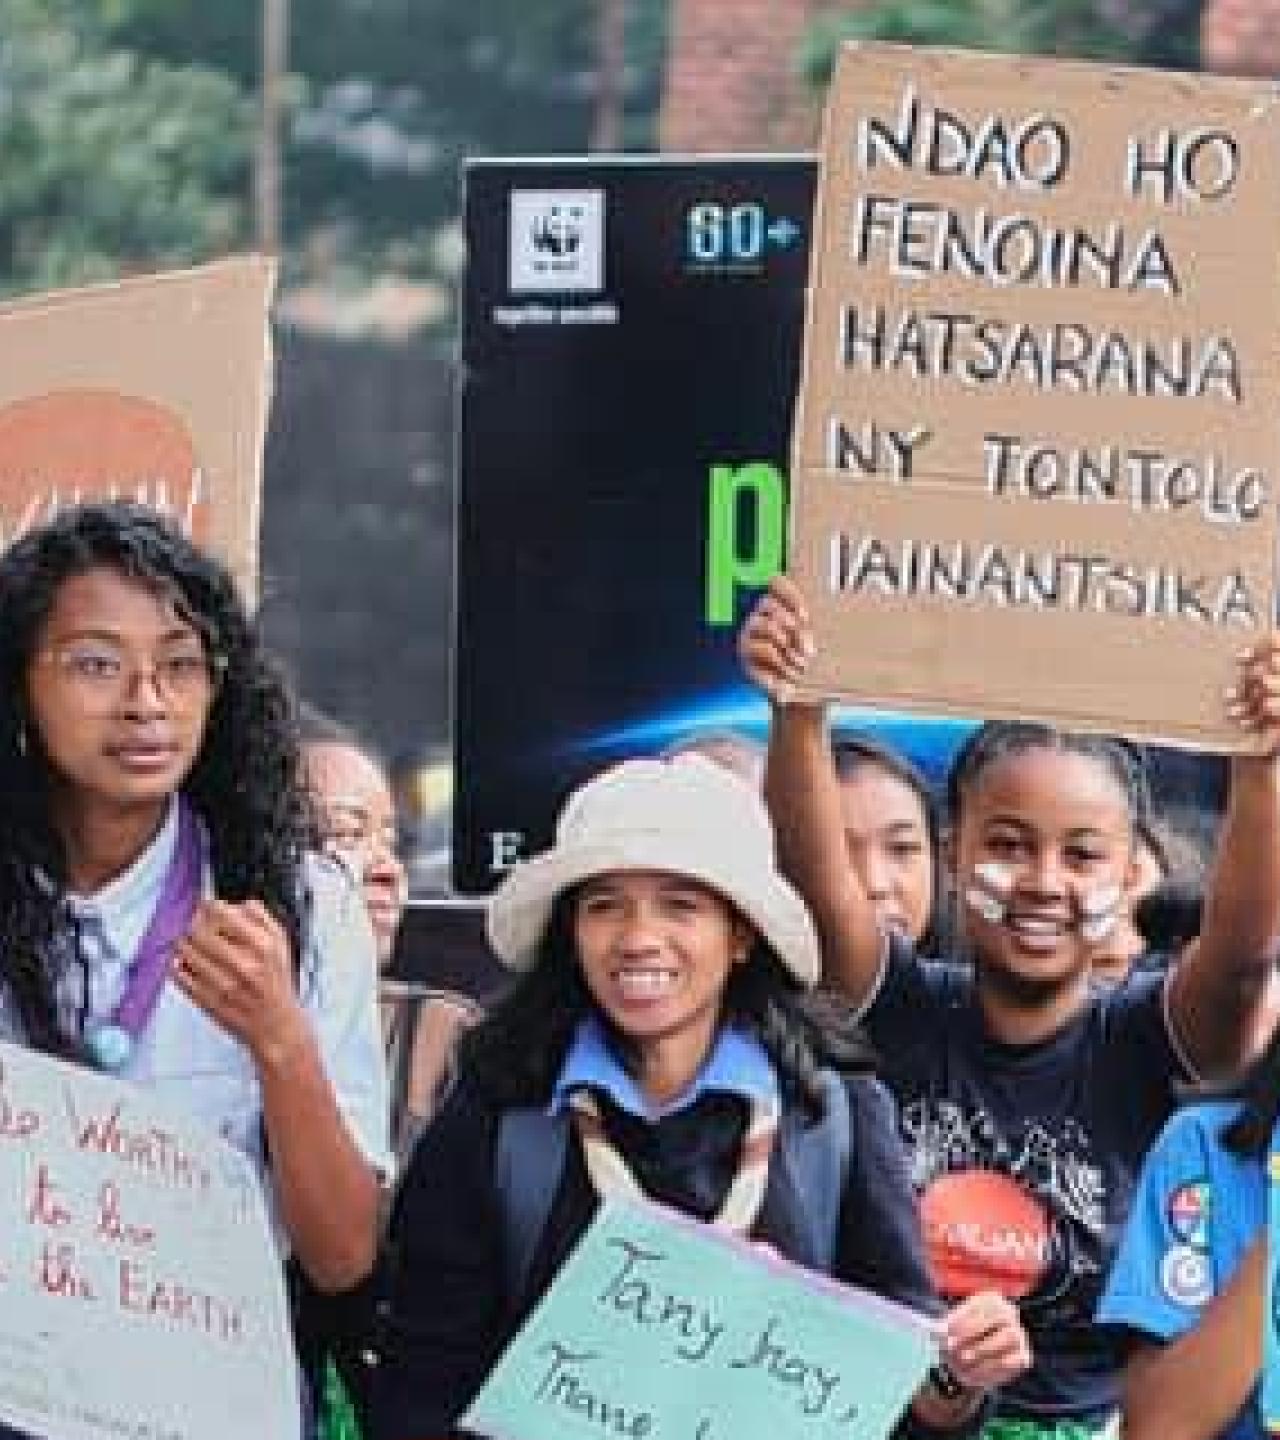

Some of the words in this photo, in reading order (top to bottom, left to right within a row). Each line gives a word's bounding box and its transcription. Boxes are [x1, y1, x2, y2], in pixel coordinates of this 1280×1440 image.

[861, 95, 1069, 188] NDAO
[1128, 129, 1238, 200] HO
[859, 196, 1180, 293] FENOINA
[843, 306, 1242, 402] HATSARANA
[833, 421, 930, 478] NY
